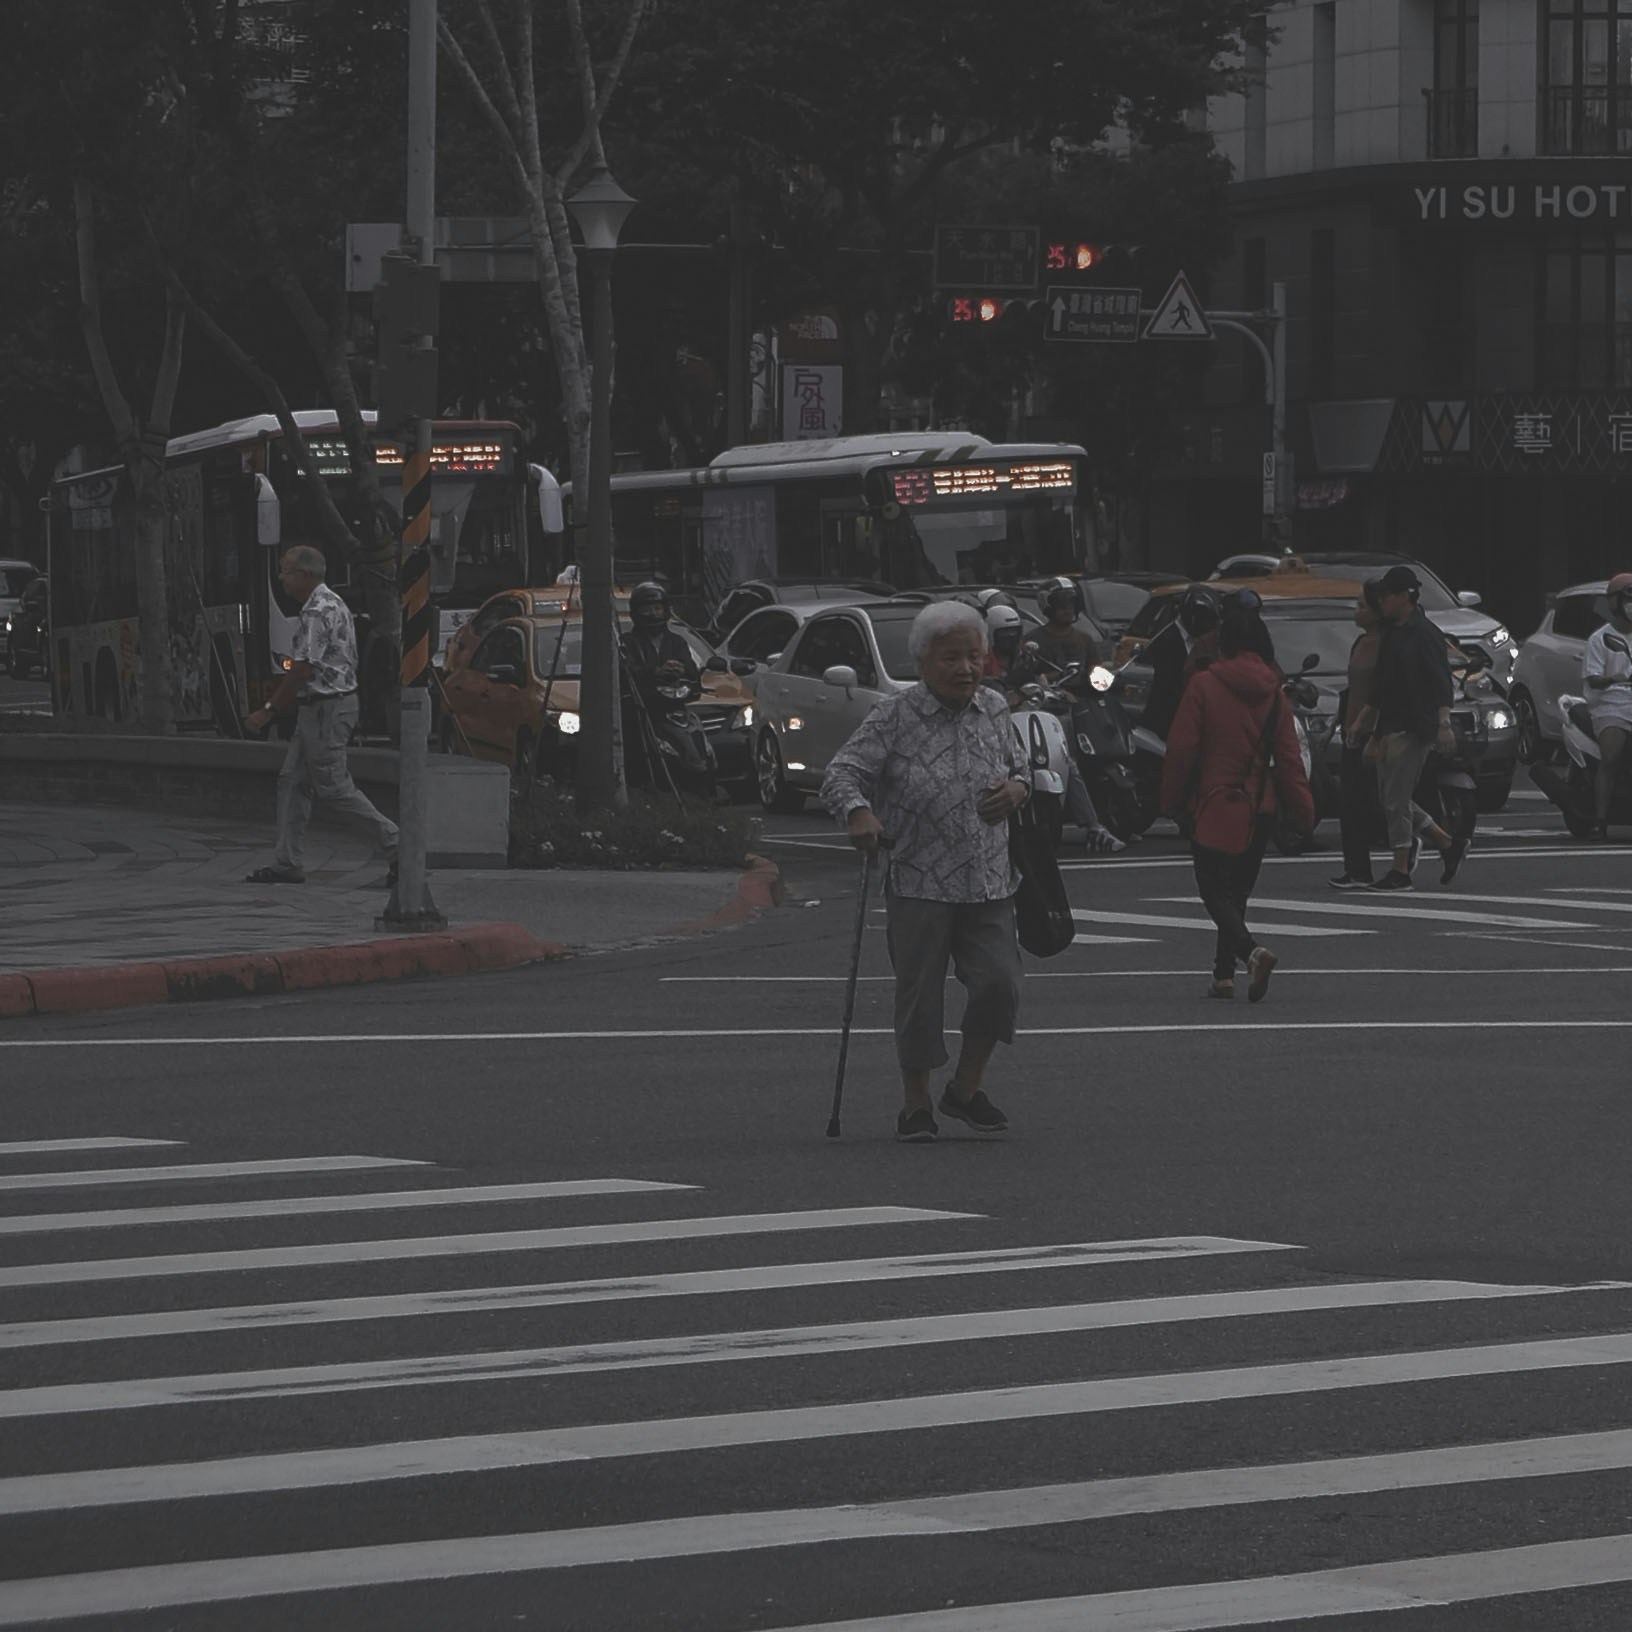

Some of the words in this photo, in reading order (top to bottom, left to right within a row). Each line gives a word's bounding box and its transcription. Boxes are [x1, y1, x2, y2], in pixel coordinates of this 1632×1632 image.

[1415, 188, 1447, 220] YI
[1462, 186, 1516, 219] SU
[793, 369, 829, 439] 戶外風
